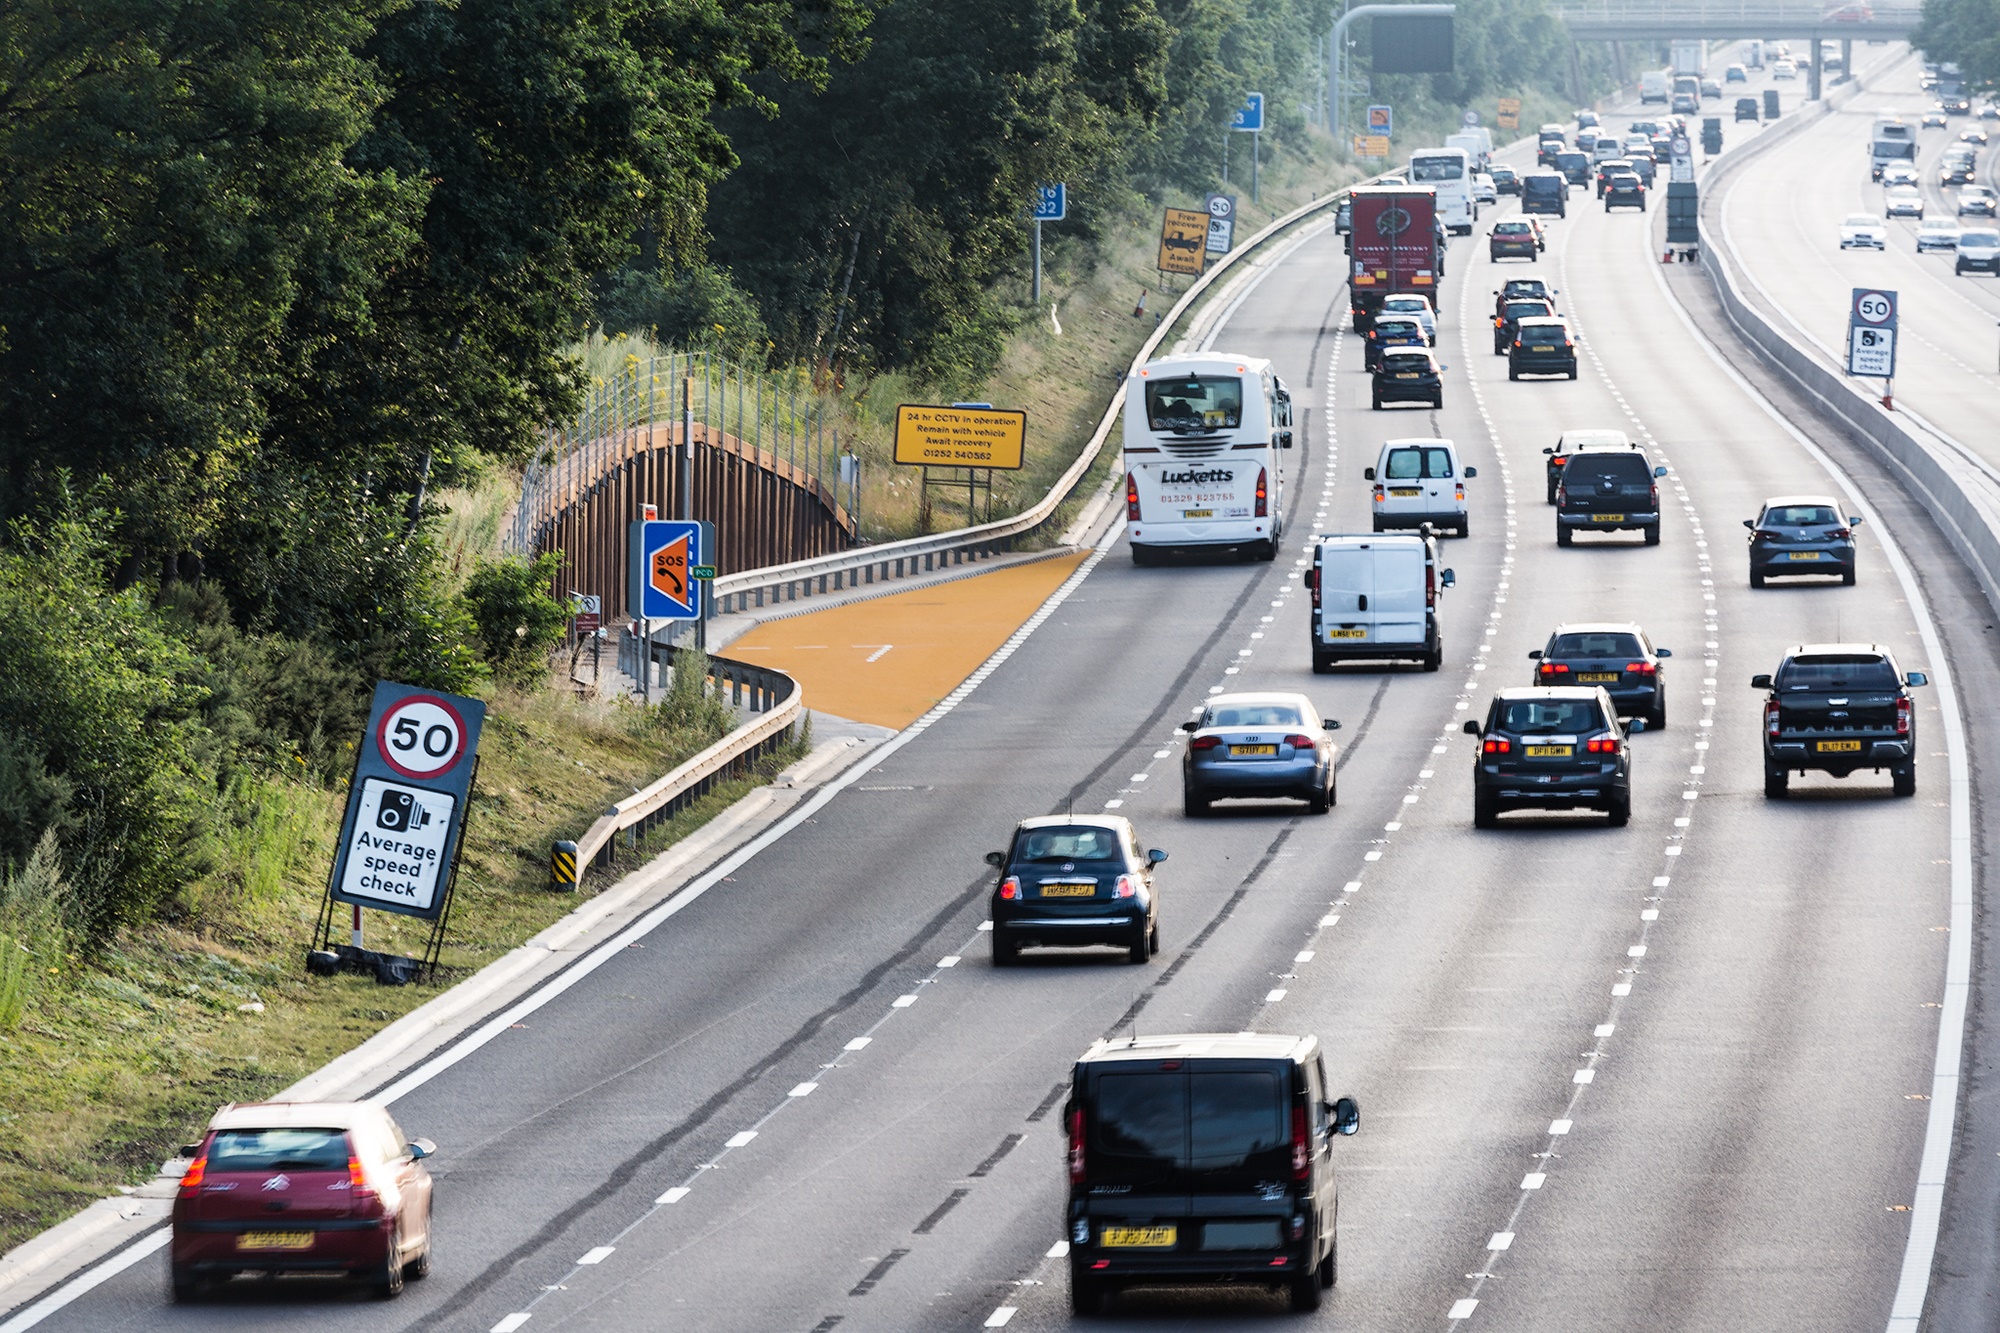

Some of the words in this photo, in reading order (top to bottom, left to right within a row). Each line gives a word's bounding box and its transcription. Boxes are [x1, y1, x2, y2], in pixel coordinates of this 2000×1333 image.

[1212, 202, 1229, 213] 50
[1178, 212, 1197, 221] Free
[1167, 220, 1205, 230] recovery
[1169, 253, 1195, 263] Await
[1166, 262, 1195, 272] rescue
[1862, 301, 1887, 315] 50
[1856, 348, 1889, 356] Average
[906, 413, 919, 421] 24
[922, 413, 932, 421] hr
[934, 414, 960, 423] CCTV
[963, 415, 972, 424] in
[973, 418, 1017, 427] operation
[916, 424, 950, 434] Remain
[952, 427, 972, 436] with
[974, 428, 1007, 438] vehicle
[926, 436, 951, 446] Await
[953, 440, 992, 449] recovery
[923, 449, 952, 459] 01252
[1161, 468, 1234, 485] Lucketts
[1161, 494, 1193, 503] 01329
[657, 555, 684, 567] SOS
[391, 717, 452, 758] 50
[357, 831, 437, 861] Average
[363, 854, 421, 878] speed
[360, 873, 417, 898] check
